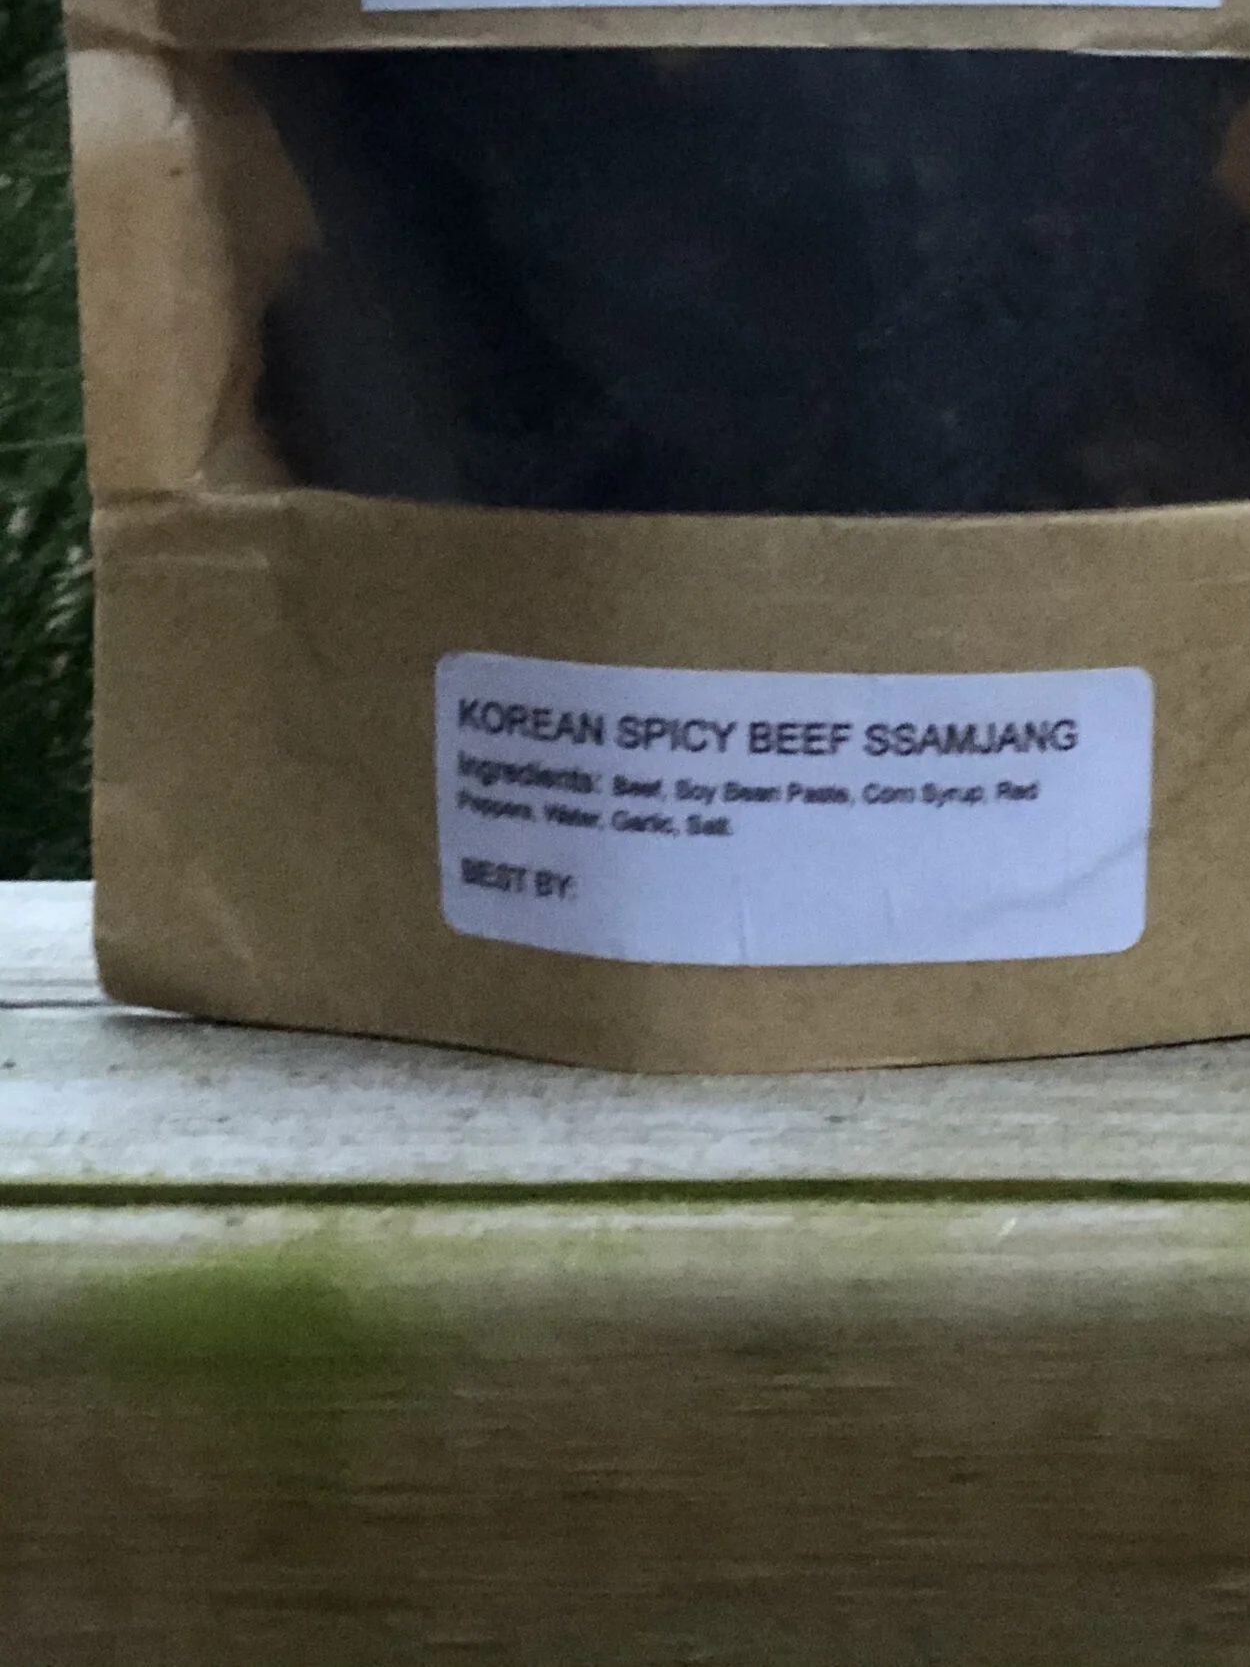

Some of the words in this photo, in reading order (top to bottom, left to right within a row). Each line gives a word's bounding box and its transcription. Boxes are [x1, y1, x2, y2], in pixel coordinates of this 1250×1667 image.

[458, 697, 605, 746] KOREAN
[616, 714, 738, 752] SPICY
[749, 721, 853, 756] BEEF
[863, 718, 1078, 756] SSAMJANG
[460, 856, 528, 893] BEST
